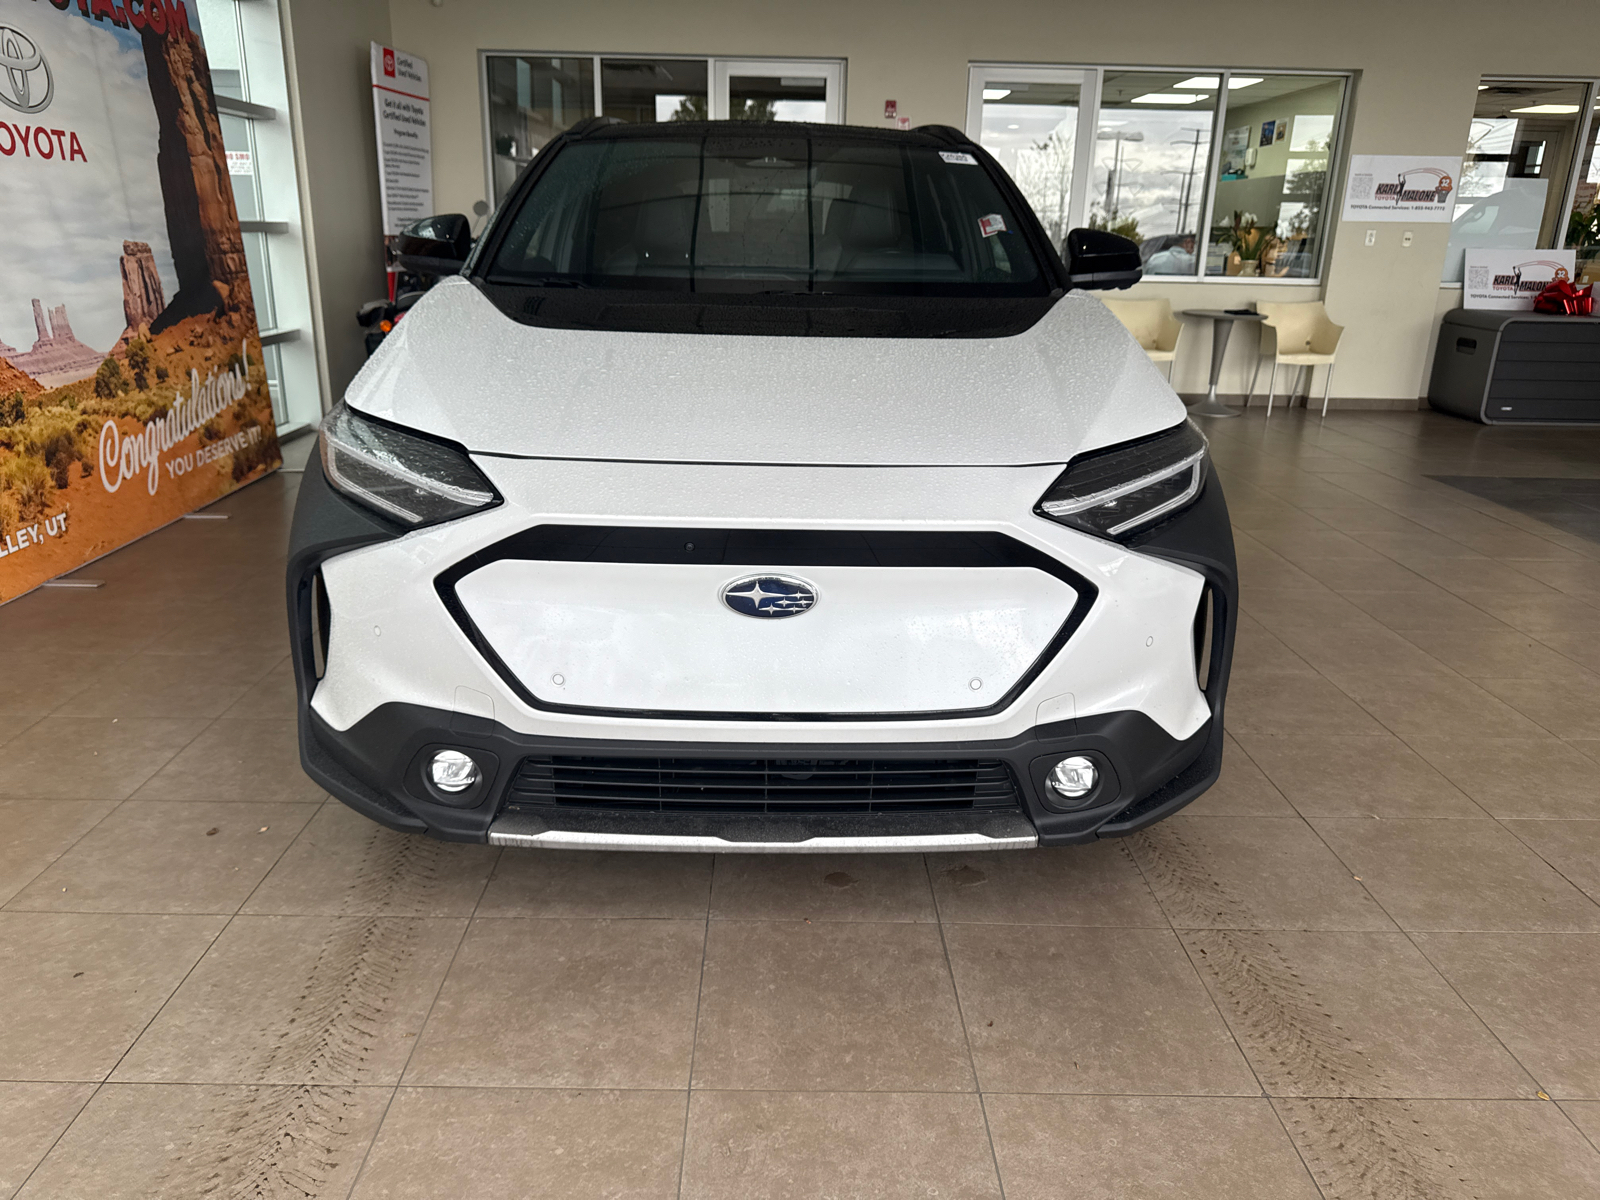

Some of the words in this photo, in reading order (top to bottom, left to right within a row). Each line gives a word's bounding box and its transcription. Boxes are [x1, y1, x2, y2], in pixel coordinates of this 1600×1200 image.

[1376, 183, 1400, 194] KARL
[1401, 190, 1437, 201] MALONE
[1494, 275, 1516, 285] KARL
[1520, 281, 1553, 292] MALON
[99, 337, 252, 496] Congratulations!
[165, 453, 194, 480] YOU
[196, 430, 249, 468] DESERVE
[246, 425, 263, 444] IT!
[45, 512, 67, 536] UT
